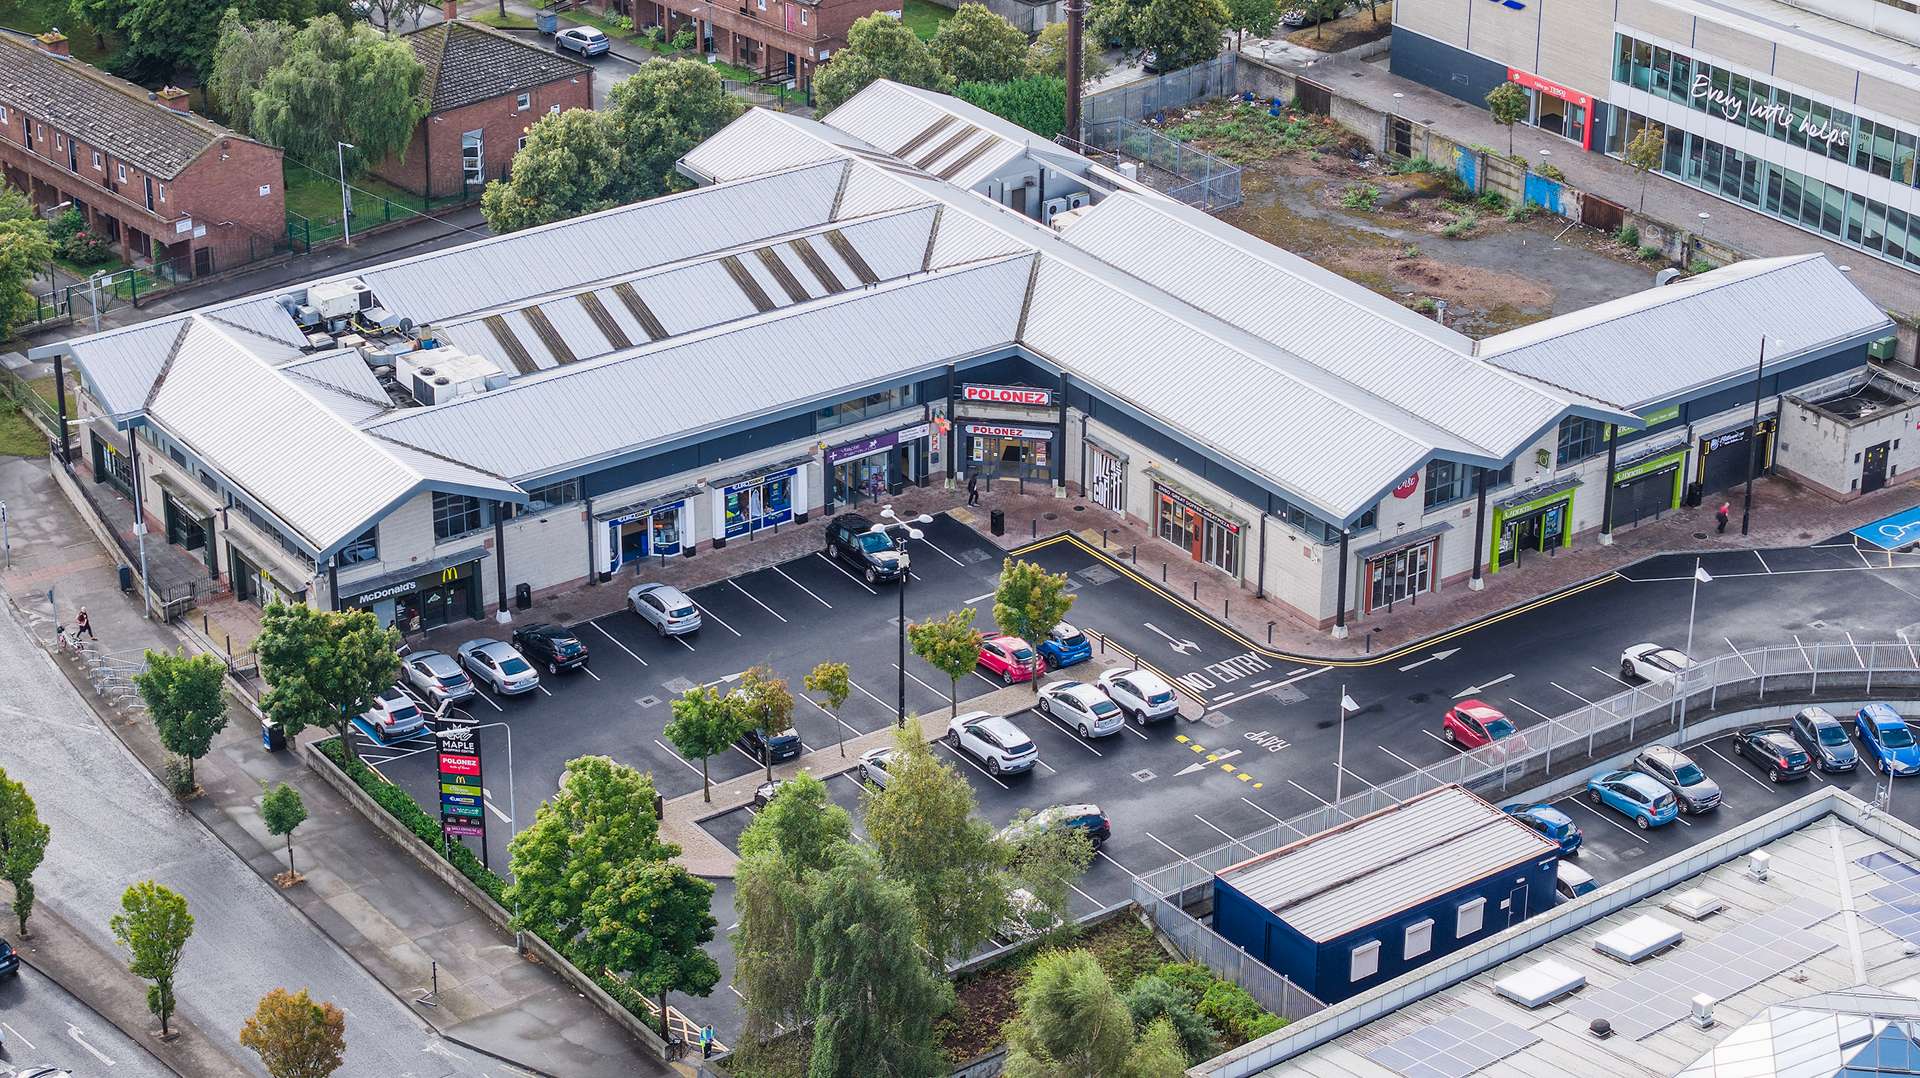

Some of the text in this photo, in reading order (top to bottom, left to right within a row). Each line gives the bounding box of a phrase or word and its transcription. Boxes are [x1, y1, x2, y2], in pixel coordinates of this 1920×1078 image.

[1690, 74, 1850, 148] Every little helps
[967, 388, 1045, 404] POLONEZ
[973, 426, 1023, 436] POLONEZ
[360, 581, 416, 603] McDonald's
[1176, 651, 1272, 693] NO ENTRY
[442, 740, 474, 750] MAPLE
[1244, 730, 1291, 752] RAMP
[442, 757, 476, 766] POLONEZ
